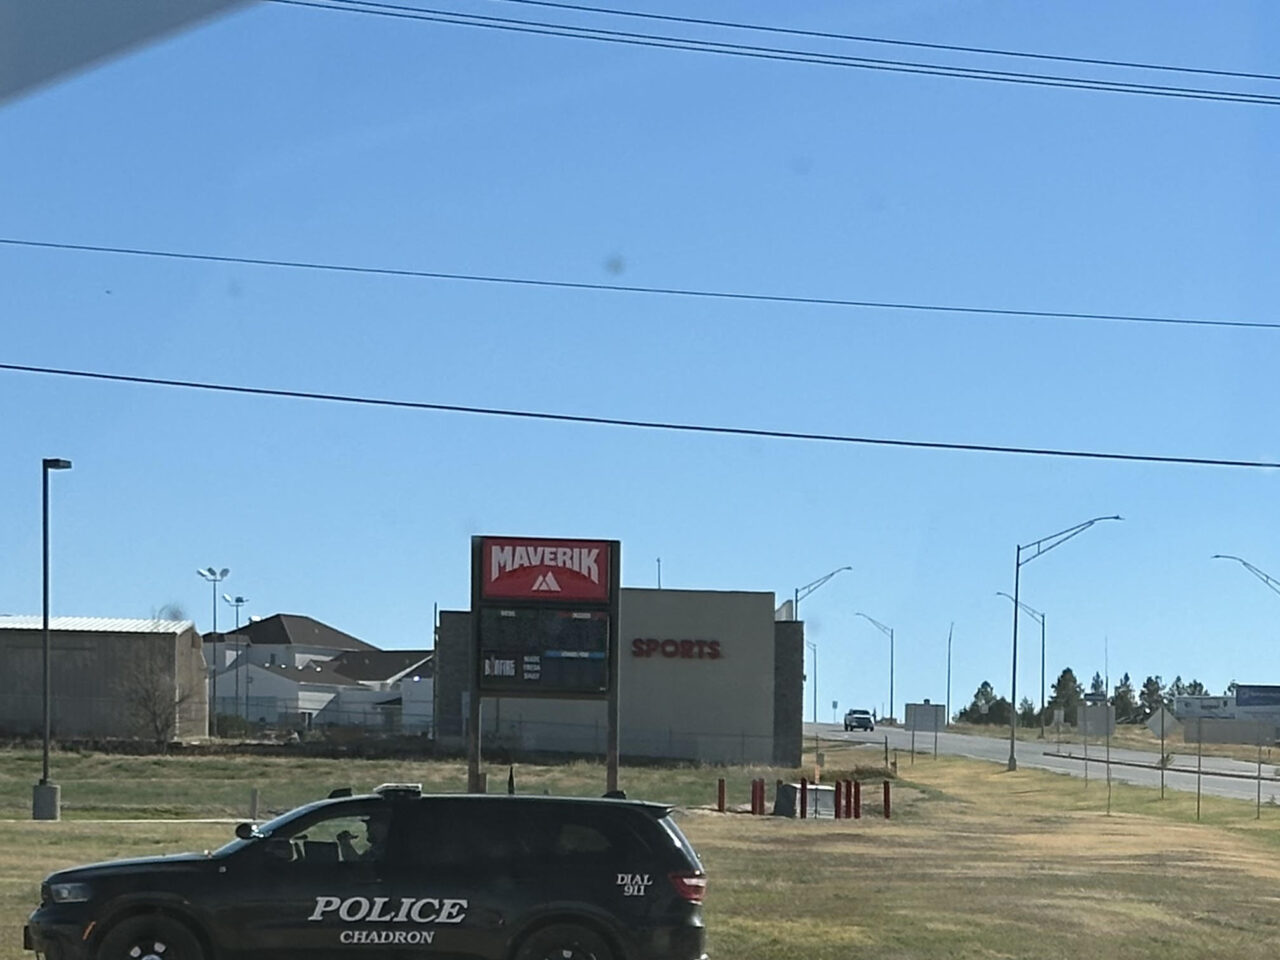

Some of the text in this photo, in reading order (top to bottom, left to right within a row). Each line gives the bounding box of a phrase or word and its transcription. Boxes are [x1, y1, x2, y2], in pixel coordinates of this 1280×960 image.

[491, 545, 600, 585] MAVERIK
[632, 638, 721, 659] SPORTS
[616, 873, 653, 886] DIAL
[623, 885, 645, 896] 911
[307, 896, 469, 923] POLICE
[340, 930, 435, 945] CHADRON
